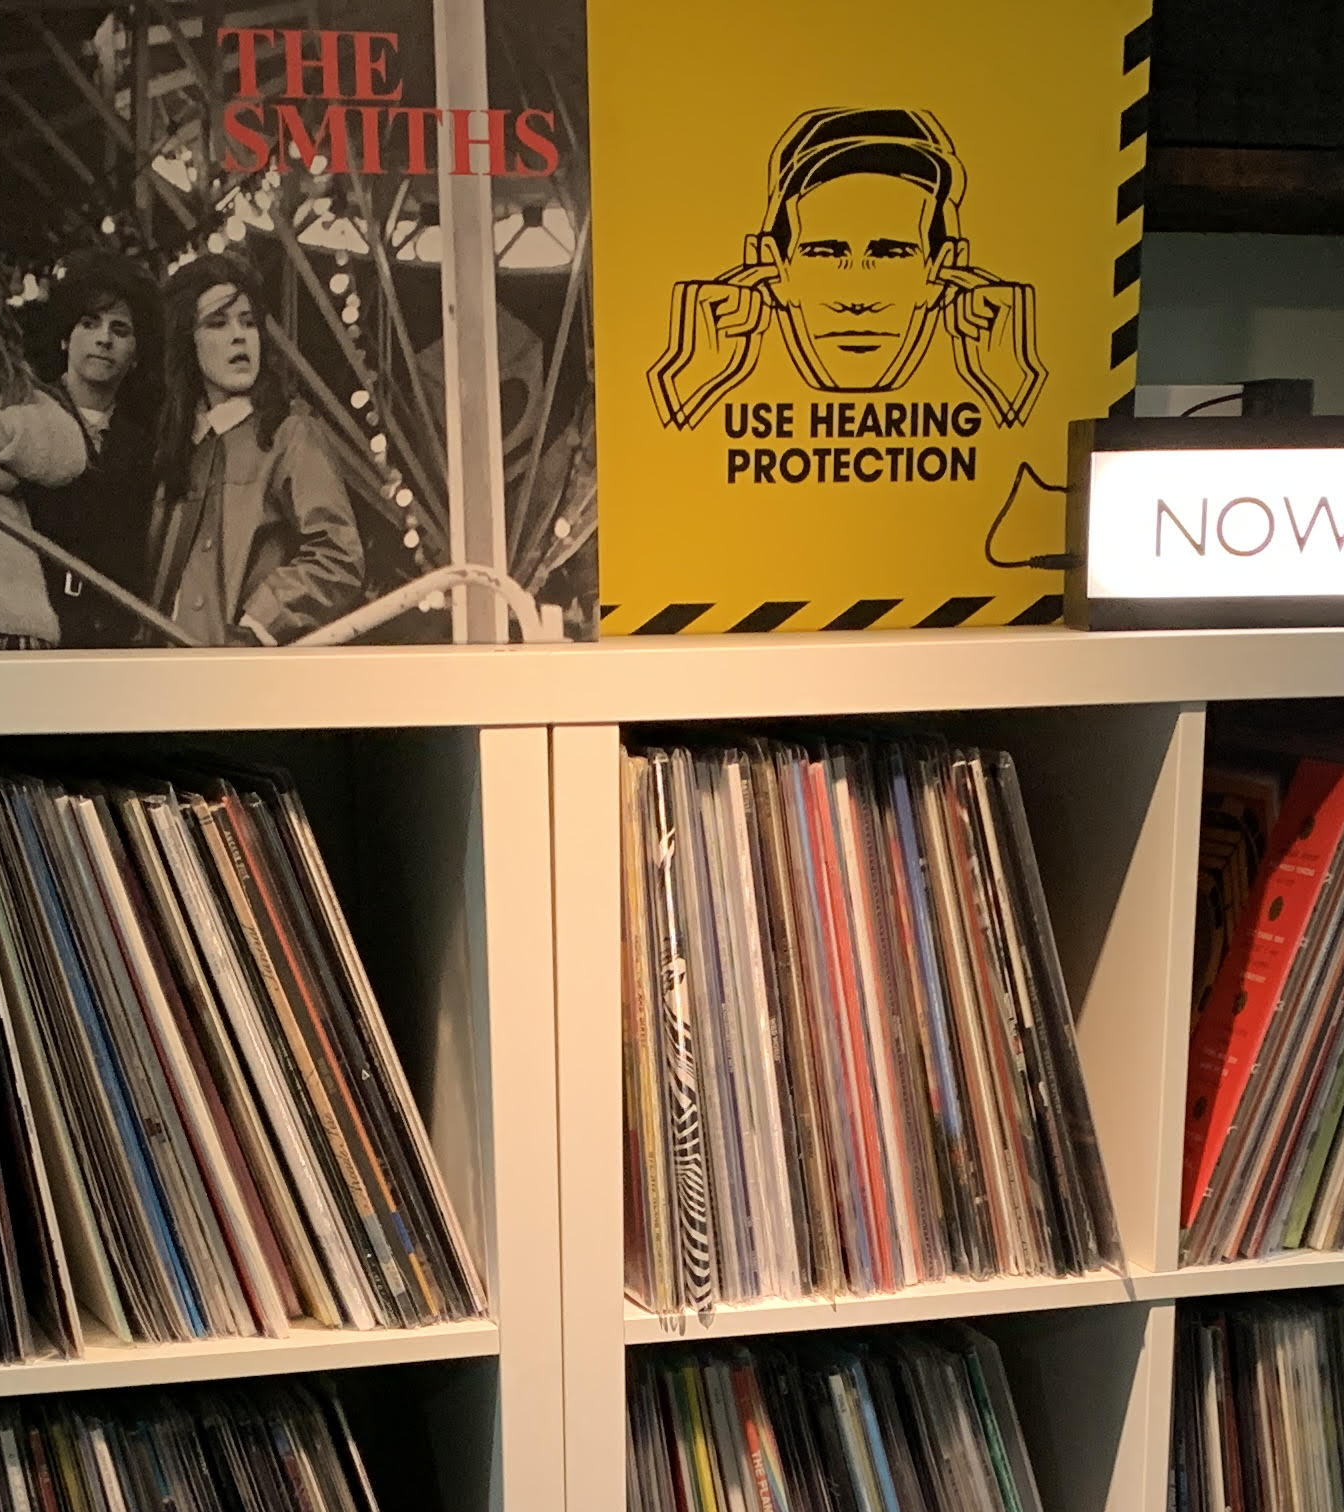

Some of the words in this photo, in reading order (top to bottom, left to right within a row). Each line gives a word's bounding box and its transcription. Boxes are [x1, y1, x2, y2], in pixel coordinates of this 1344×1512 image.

[217, 28, 403, 100] THE
[222, 102, 558, 177] SMITHS
[725, 402, 793, 438] USE
[809, 402, 982, 438] HEARING
[727, 446, 976, 484] PROTECTION
[749, 1449, 766, 1478] THE
